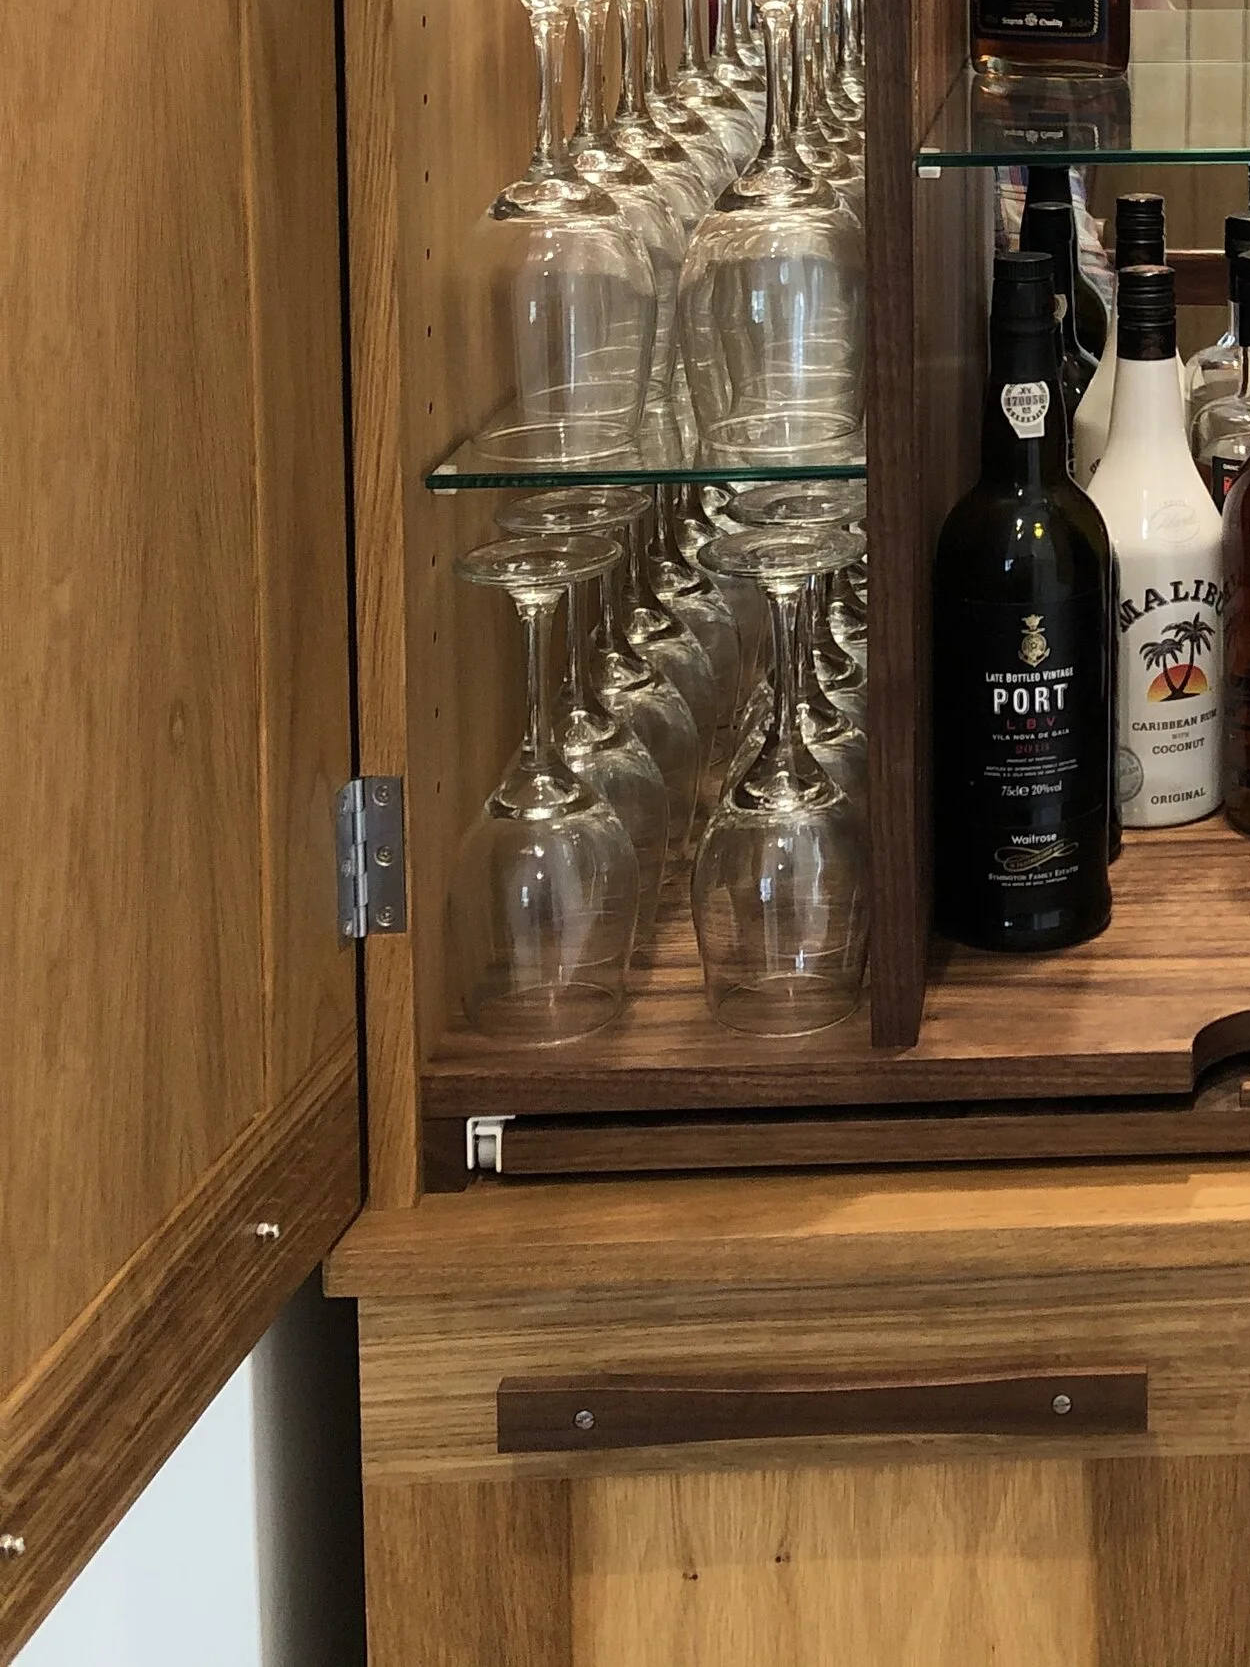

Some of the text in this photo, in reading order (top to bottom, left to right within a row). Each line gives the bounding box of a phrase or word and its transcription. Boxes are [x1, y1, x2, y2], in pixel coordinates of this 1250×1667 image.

[985, 666, 1074, 683] LATE BOTTLED VINTAGE
[993, 683, 1068, 715] PORT
[1132, 708, 1218, 732] CARIBBEAN RUM
[992, 733, 1011, 741] VILA
[1013, 733, 1036, 741] NOVA
[1037, 731, 1049, 739] DE
[1152, 738, 1206, 755] COCONUT
[1150, 787, 1206, 805] ORIGINAL
[1011, 833, 1058, 845] Waitrose
